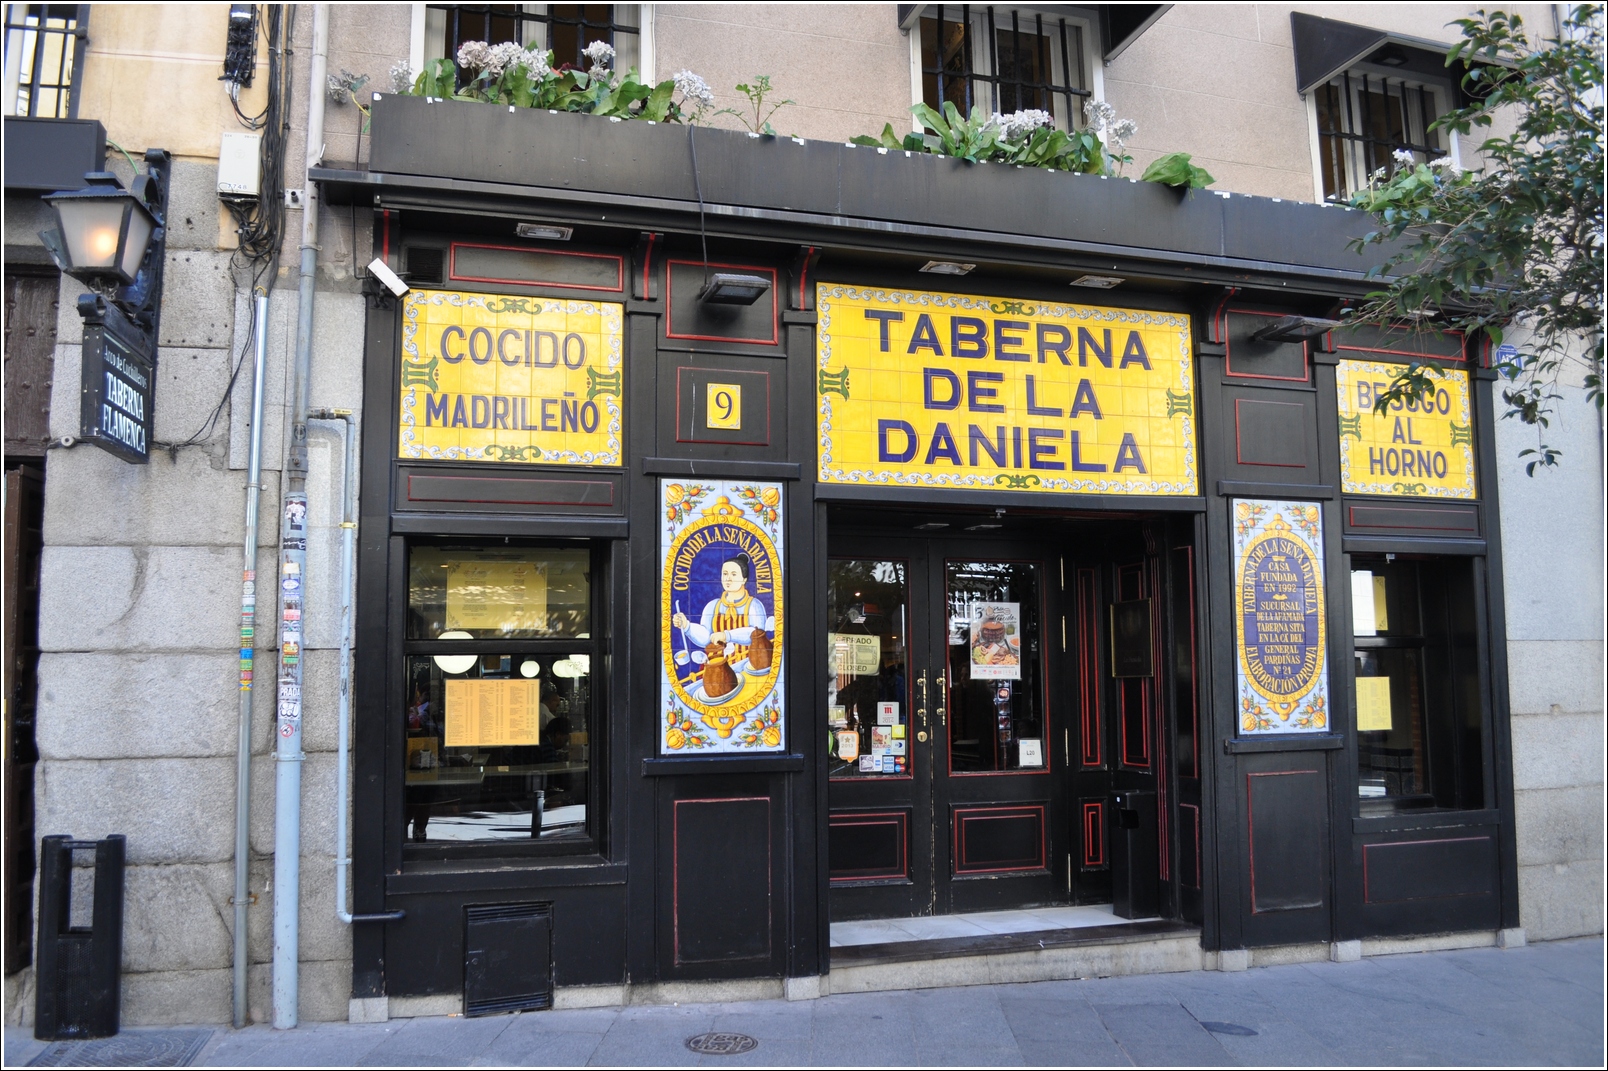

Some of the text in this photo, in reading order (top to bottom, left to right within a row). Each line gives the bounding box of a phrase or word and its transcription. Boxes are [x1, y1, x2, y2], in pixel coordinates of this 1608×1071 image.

[440, 325, 587, 370] COCIDO
[864, 309, 1154, 371] TABERNA
[104, 345, 116, 366] Arco
[117, 353, 123, 371] de
[106, 371, 144, 422] TABERNA
[715, 391, 733, 420] 9
[923, 367, 1104, 420] DE LA
[425, 391, 600, 434] MADRILEÑO
[102, 403, 146, 454] FLAMENCA
[1392, 416, 1422, 445] AL
[878, 419, 1148, 474] DANIELA
[1369, 447, 1448, 478] HORNO
[673, 545, 696, 591] COCIDO
[688, 532, 707, 553] DE
[703, 526, 722, 544] LA
[748, 541, 772, 594] DANIELA
[1268, 562, 1291, 571] CASA
[1244, 556, 1260, 615] TABERNA
[1252, 546, 1267, 561] DE
[1265, 540, 1279, 554] LA
[1300, 561, 1317, 615] DANIELA
[1260, 572, 1298, 582] FUNDADA
[1264, 583, 1297, 592] EN 1992
[1256, 612, 1306, 622] DE LA AFAMADA
[1260, 601, 1300, 611] SUCURSAL
[1257, 622, 1306, 633] TABERNA SITA
[1259, 633, 1269, 643] EN
[1269, 633, 1280, 643] LA
[1290, 634, 1304, 643] DEL
[1264, 645, 1299, 655] GENERAL
[1264, 654, 1301, 665] PARDIÑAS
[1246, 646, 1317, 693] ELABORACIÓN PROPIA
[1282, 665, 1292, 675] 21
